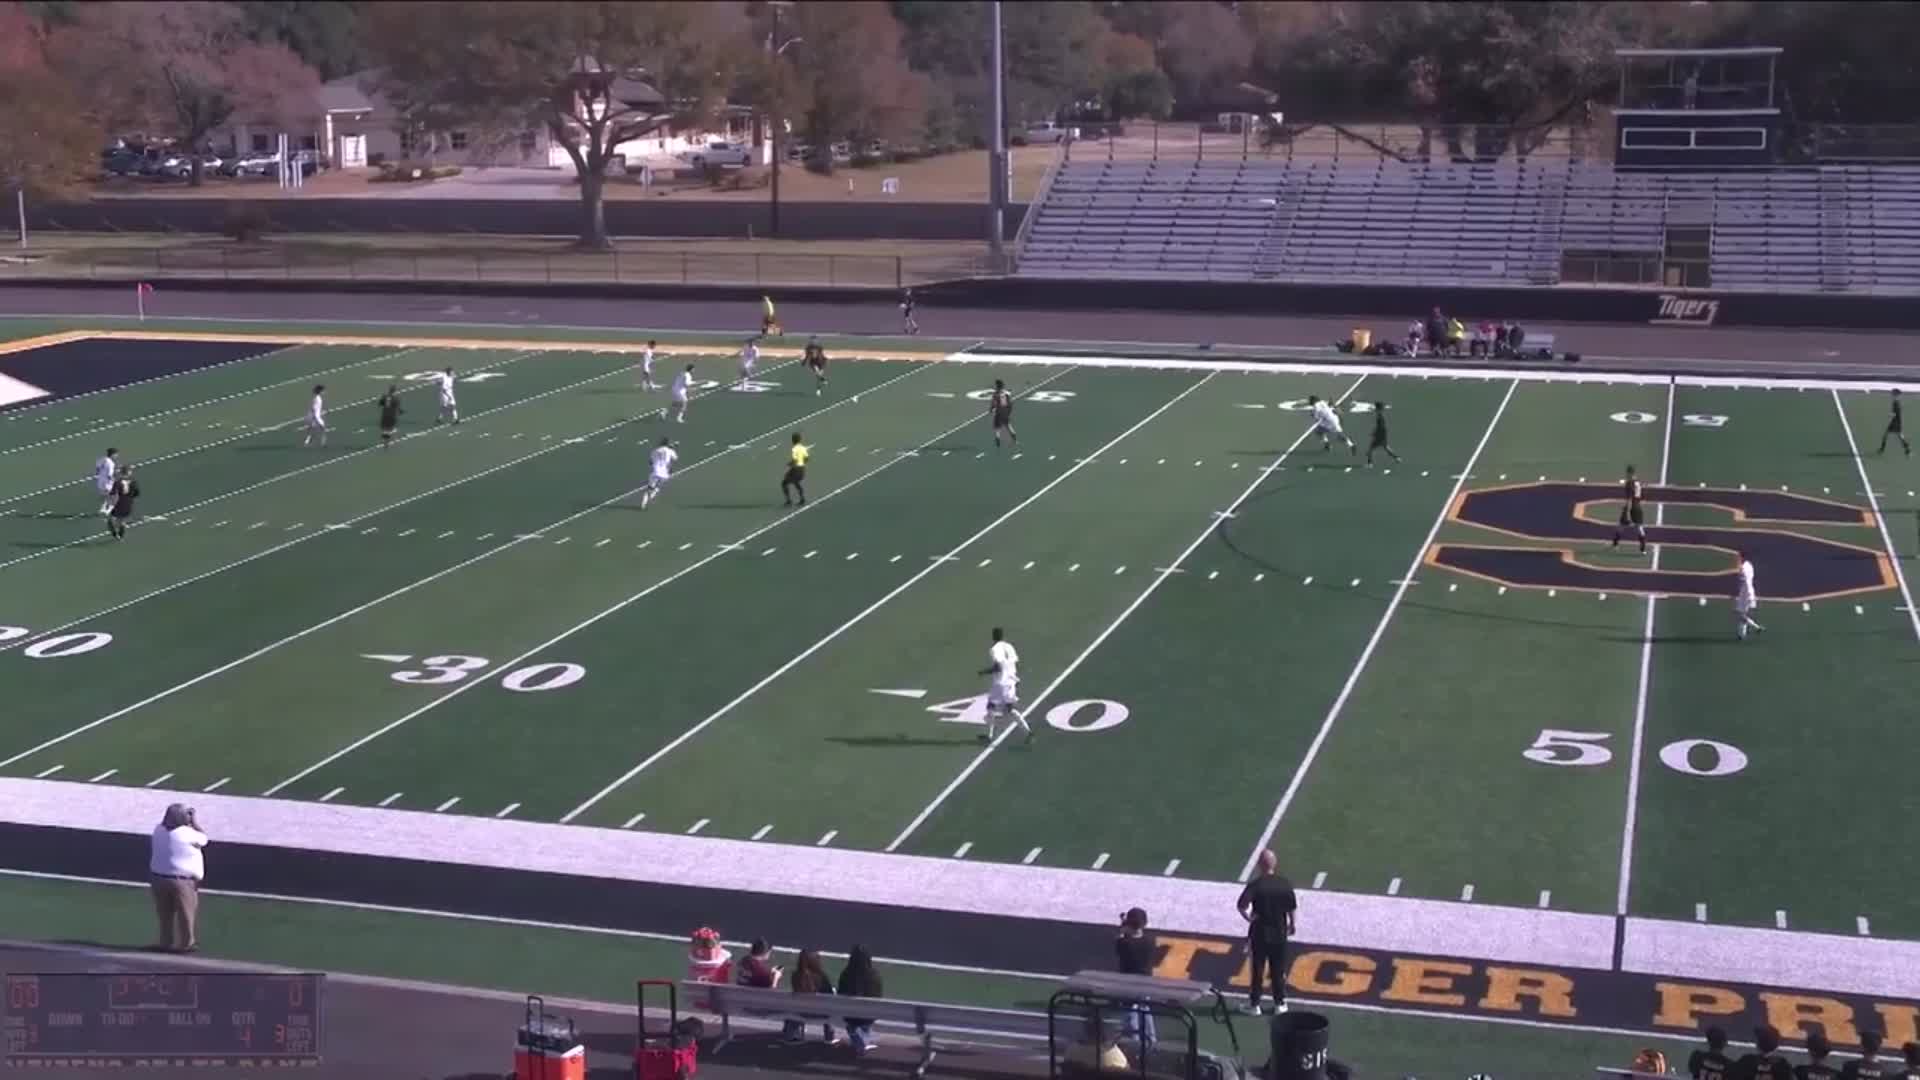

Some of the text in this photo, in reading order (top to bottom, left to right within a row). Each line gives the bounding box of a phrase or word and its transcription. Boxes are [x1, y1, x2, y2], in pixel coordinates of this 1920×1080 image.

[1655, 294, 1720, 327] Tigers
[390, 655, 586, 692] 30
[925, 693, 1129, 732] 40
[1522, 729, 1748, 776] 50
